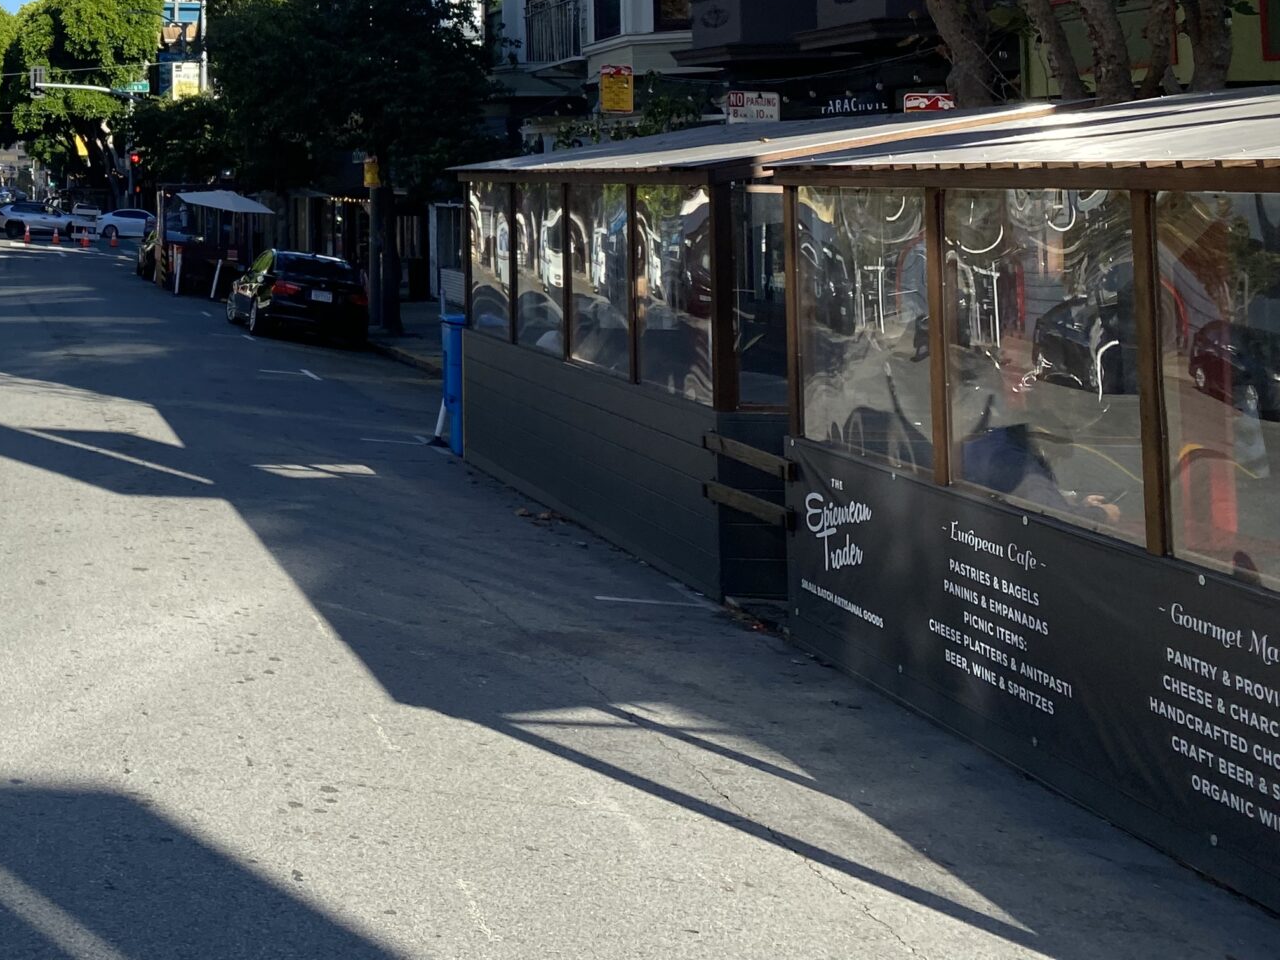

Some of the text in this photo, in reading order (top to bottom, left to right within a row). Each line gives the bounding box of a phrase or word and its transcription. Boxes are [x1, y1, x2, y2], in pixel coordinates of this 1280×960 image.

[729, 93, 744, 107] NO
[732, 109, 739, 118] 8
[756, 109, 765, 119] 10
[831, 478, 843, 490] THE
[805, 492, 872, 532] Epicurean
[815, 527, 863, 572] Trader
[1007, 543, 1037, 572] Cafe
[801, 578, 884, 629] SMALL BATCH ARTISANAL GOODS
[949, 558, 1040, 607] PASTRIES & BAGELS
[943, 579, 1049, 636] PANINIS & EMPANADAS
[963, 611, 1028, 652] PICNIC ITEMS:
[1171, 602, 1243, 649] Gourmet
[928, 618, 1073, 698] CHEESE PLATTERS & ANITPASTI
[945, 649, 1055, 715] BEER, WINE & SPRITZES
[1166, 647, 1279, 708] PANTRY & PROVI
[1149, 696, 1248, 754] HANDCRAFTED
[1162, 674, 1280, 738] CHEESE & CHARC
[1171, 735, 1214, 768] CRAFT
[1218, 757, 1254, 789] BEER
[1258, 777, 1268, 794] &
[1191, 774, 1255, 818] ORGANIC
